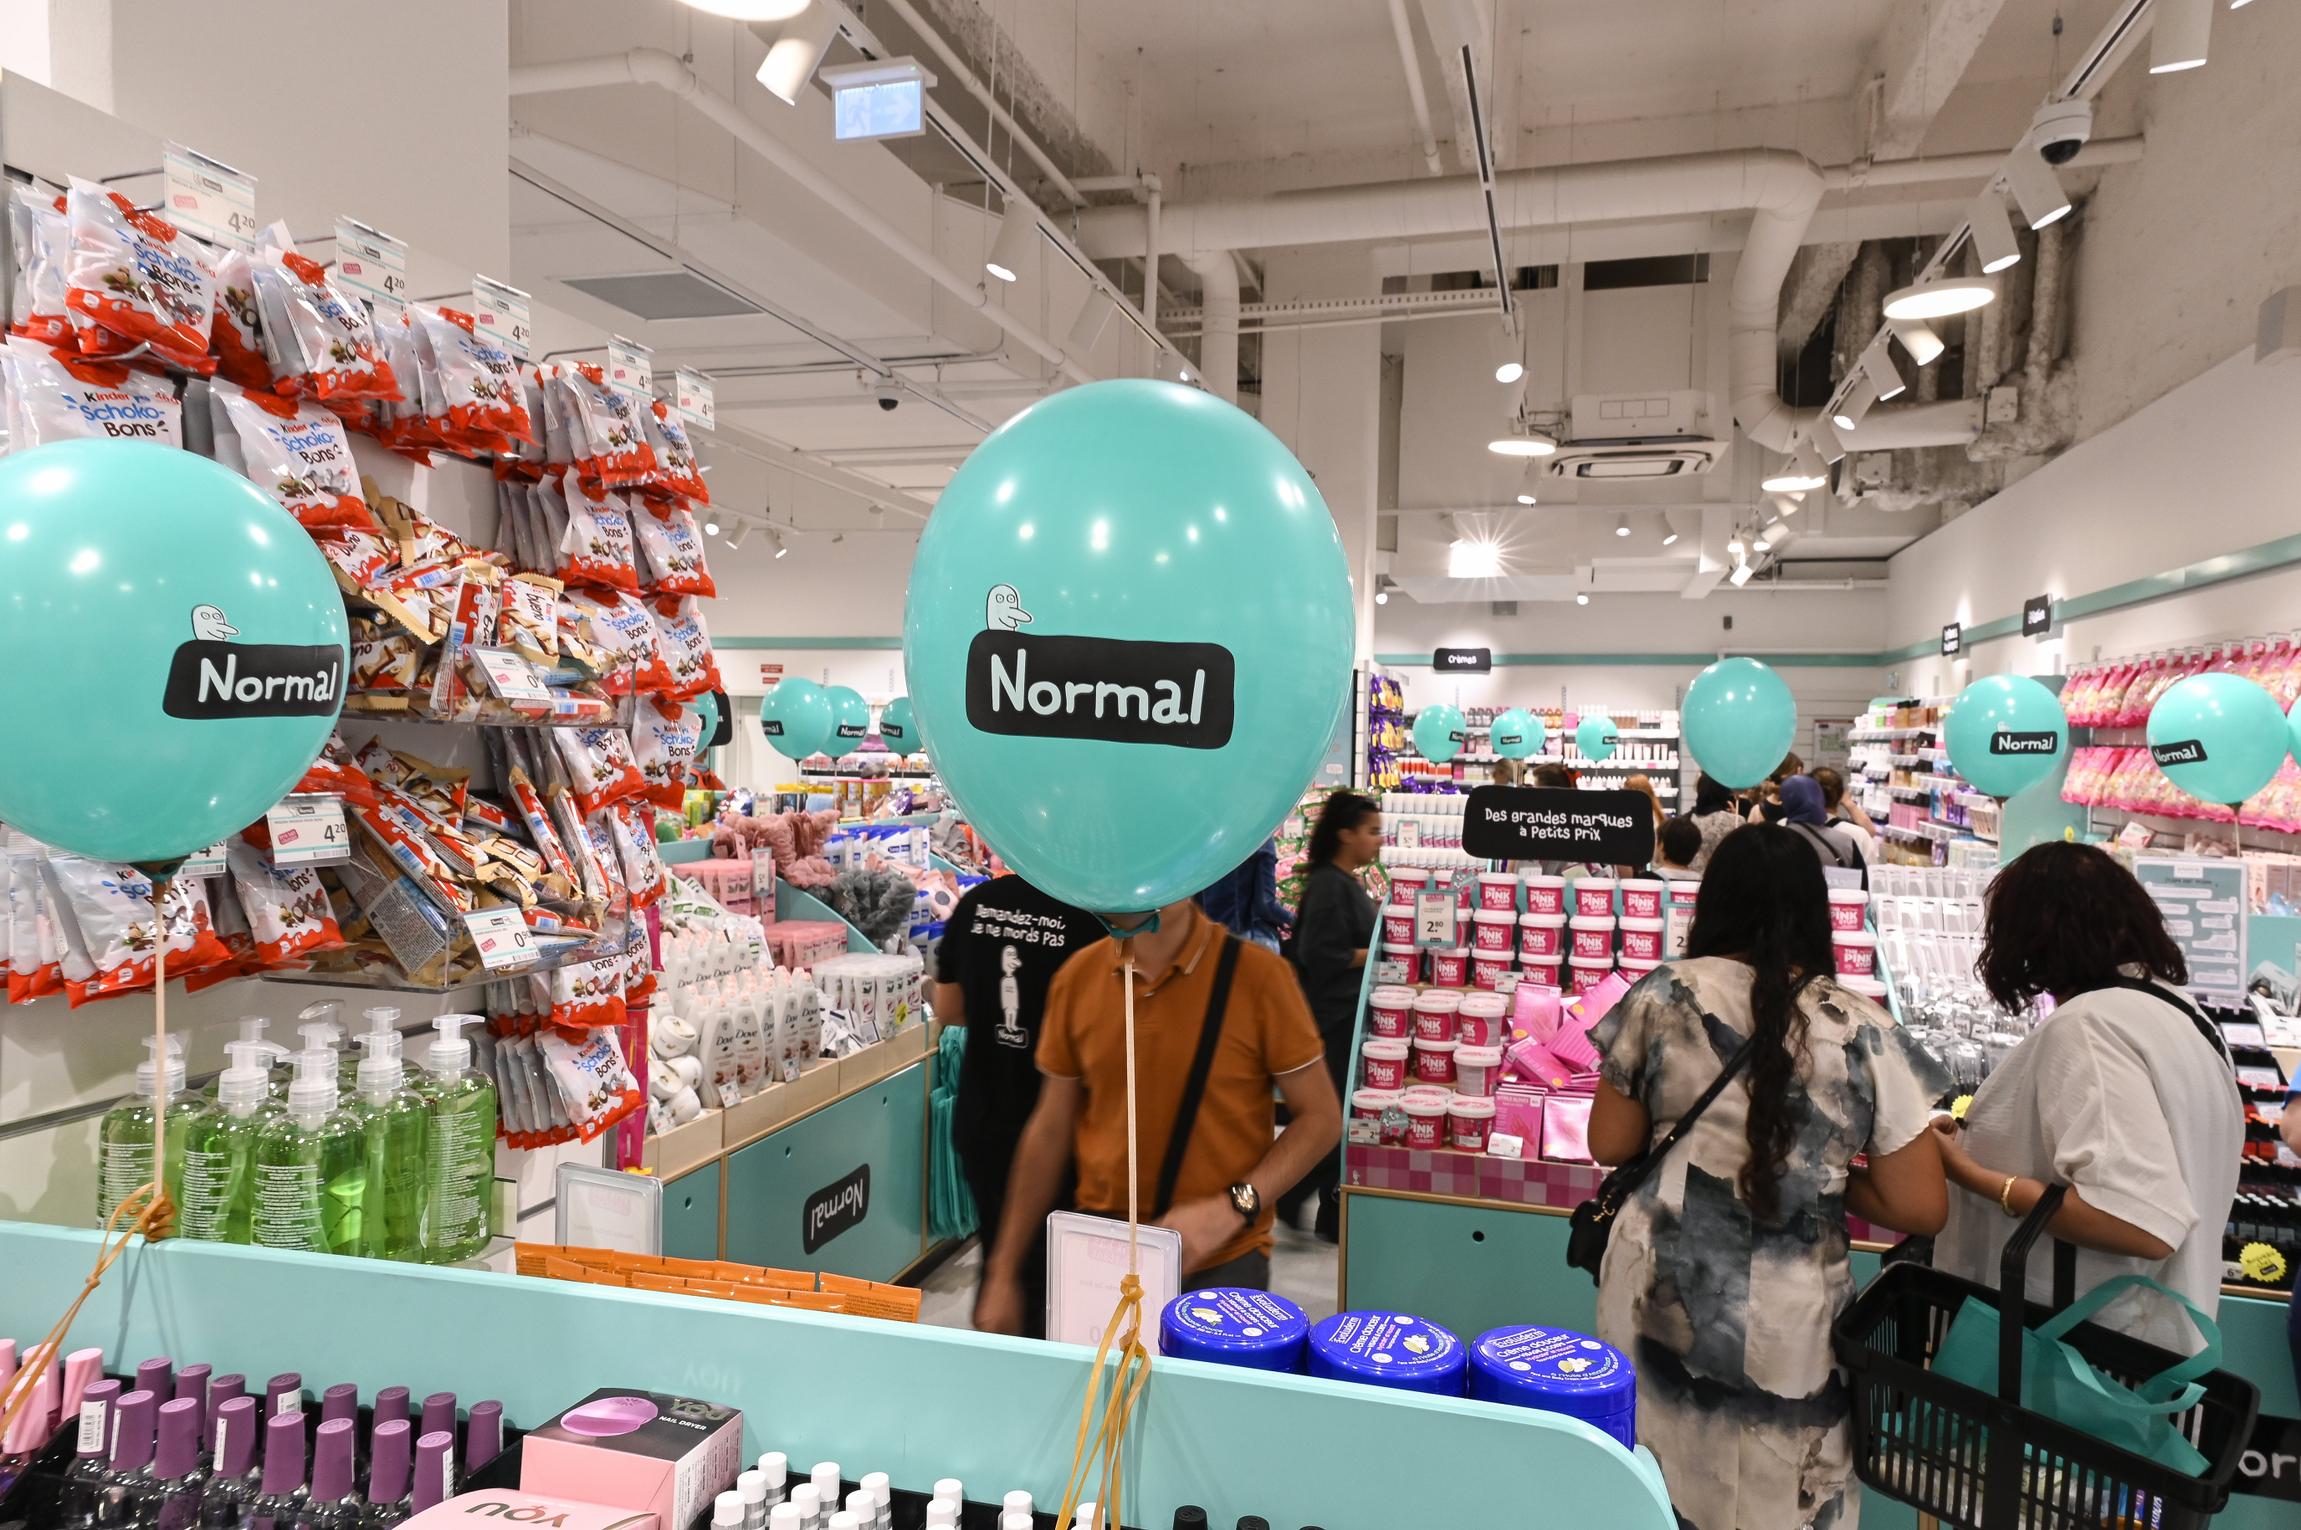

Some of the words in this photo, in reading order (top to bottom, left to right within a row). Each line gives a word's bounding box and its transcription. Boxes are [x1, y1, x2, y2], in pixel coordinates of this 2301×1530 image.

[83, 391, 130, 403] Kinder
[80, 403, 165, 421] Schoko-
[103, 421, 156, 438] Bons
[282, 432, 335, 452] Schoko-
[299, 446, 335, 466] Bons
[626, 625, 648, 640] Bons
[198, 654, 338, 703] Normal
[990, 648, 1206, 726] Normal
[840, 727, 866, 736] Normal
[1998, 735, 2054, 752] Normal
[1485, 808, 1507, 822] Des
[1511, 810, 1567, 824] grandes
[1571, 813, 1633, 828] marques
[1519, 825, 1527, 837] à
[1394, 885, 1415, 895] PIN
[1485, 889, 1511, 901] PINK
[1530, 893, 1555, 905] PINK
[1581, 895, 1608, 907] PINK
[1628, 896, 1654, 908] PINK
[1003, 926, 1039, 942] mords
[1478, 929, 1503, 941] PINK
[1577, 936, 1603, 948] PINK
[1626, 937, 1653, 949] PINK
[1844, 952, 1872, 963] PINK
[1439, 962, 1457, 974] INK
[801, 1007, 818, 1017] Dove
[735, 1029, 758, 1039] Dove
[595, 1057, 617, 1080] Bons
[1420, 1057, 1447, 1069] PINK
[1368, 1066, 1394, 1078] PINK
[811, 1179, 863, 1240] Normal
[1496, 1345, 1530, 1358] Crème
[659, 1416, 677, 1424] NAIL
[679, 1420, 707, 1431] DRYER
